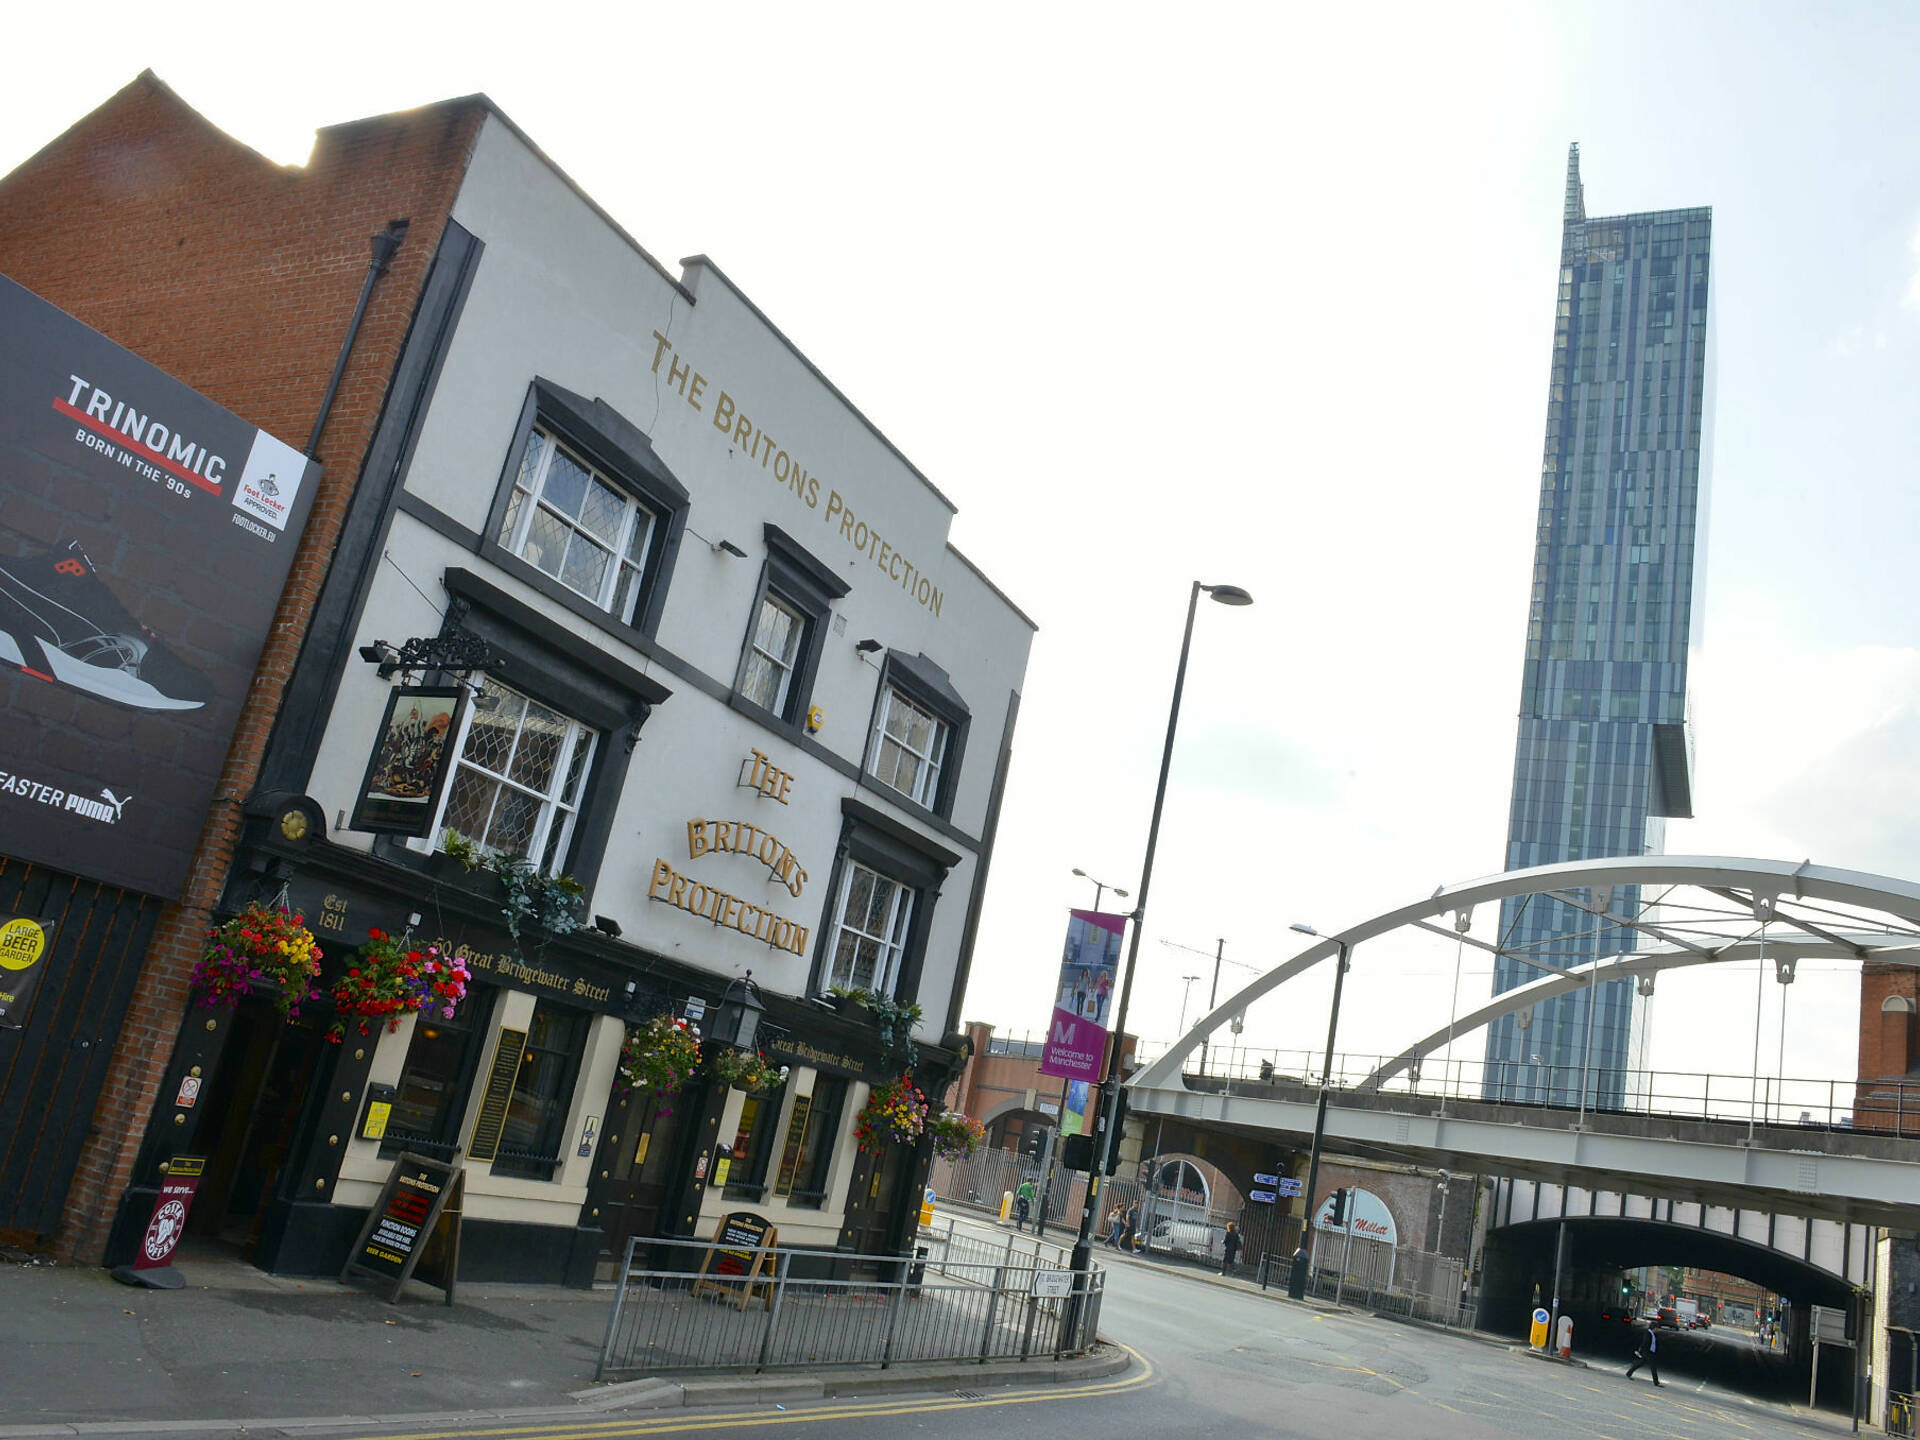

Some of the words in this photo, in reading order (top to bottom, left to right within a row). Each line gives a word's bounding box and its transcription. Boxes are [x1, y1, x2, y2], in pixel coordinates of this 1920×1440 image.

[67, 374, 227, 485] TRINOMIC
[75, 428, 116, 458] BORN
[117, 450, 134, 469] IN
[135, 459, 162, 483] THE
[650, 329, 708, 412] THE
[713, 390, 820, 510] BRITONS
[824, 489, 944, 618] PROTECTION
[244, 484, 260, 498] Foot
[261, 493, 285, 512] Locker
[232, 513, 277, 543] FOOTLOCKER.EU
[750, 747, 795, 806] THE
[64, 793, 115, 824] PUMA
[687, 817, 808, 898] BRITONS
[323, 894, 348, 912] Est
[648, 857, 810, 957] PROTECTION
[9, 923, 40, 939] LARGE
[318, 911, 345, 931] 1811
[2, 934, 38, 953] BEER
[454, 943, 495, 969] Great
[495, 953, 571, 991] Bridgewater
[572, 977, 610, 1002] Street
[1053, 1021, 1076, 1045] M
[1050, 1055, 1092, 1070] Manchester
[1051, 1047, 1085, 1060] Welcome
[1086, 1053, 1093, 1061] to
[158, 1202, 183, 1220] COSTA
[146, 1236, 176, 1257] COFFEE
